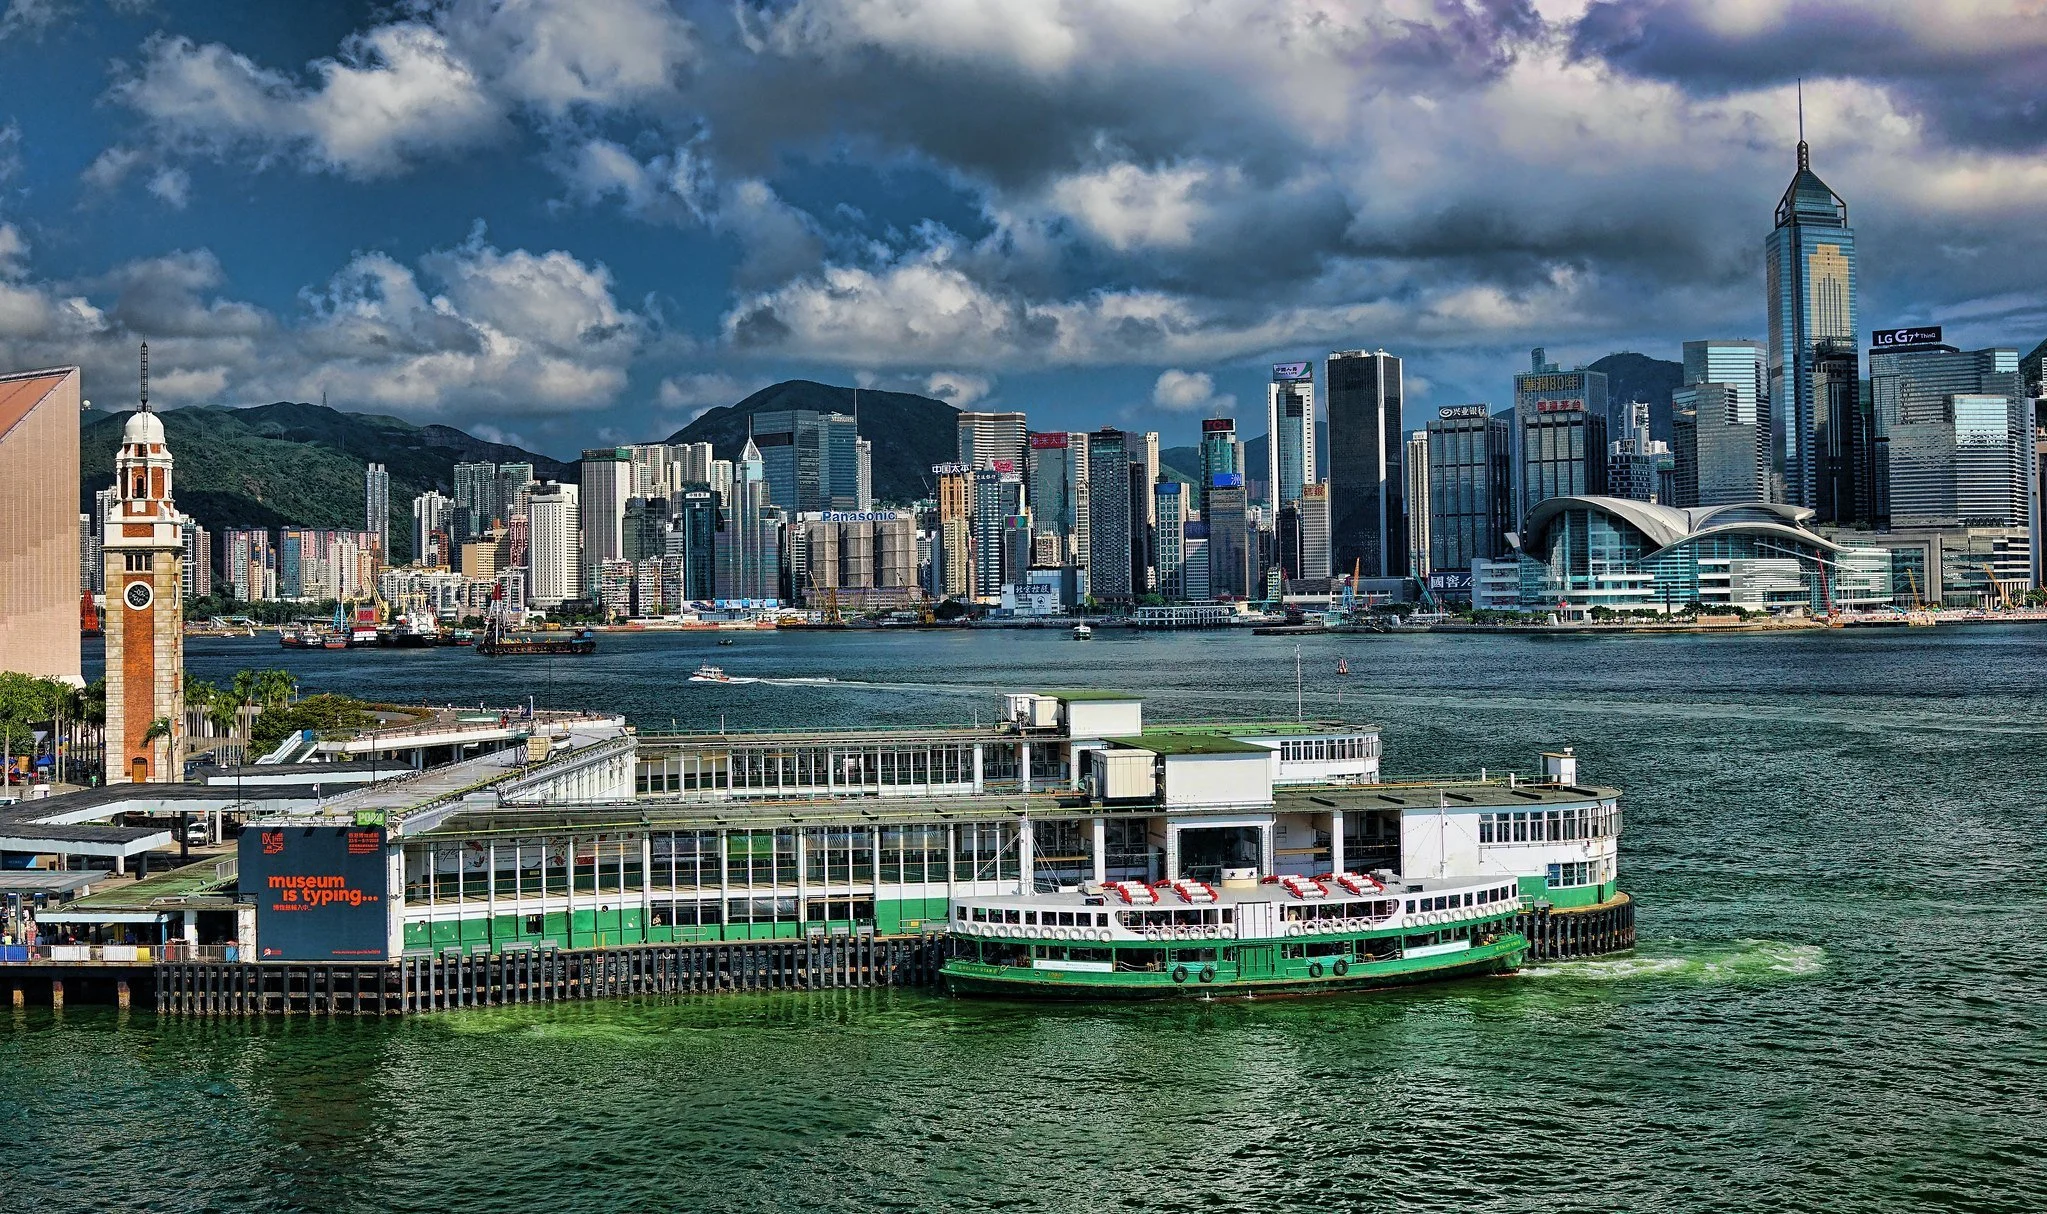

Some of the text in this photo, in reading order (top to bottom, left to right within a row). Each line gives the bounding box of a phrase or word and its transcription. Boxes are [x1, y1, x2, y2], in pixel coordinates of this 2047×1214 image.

[1878, 334, 1893, 344] LG
[1205, 420, 1231, 430] TCL
[822, 511, 896, 522] Panasonic
[268, 875, 345, 888] museum
[283, 889, 298, 901] is
